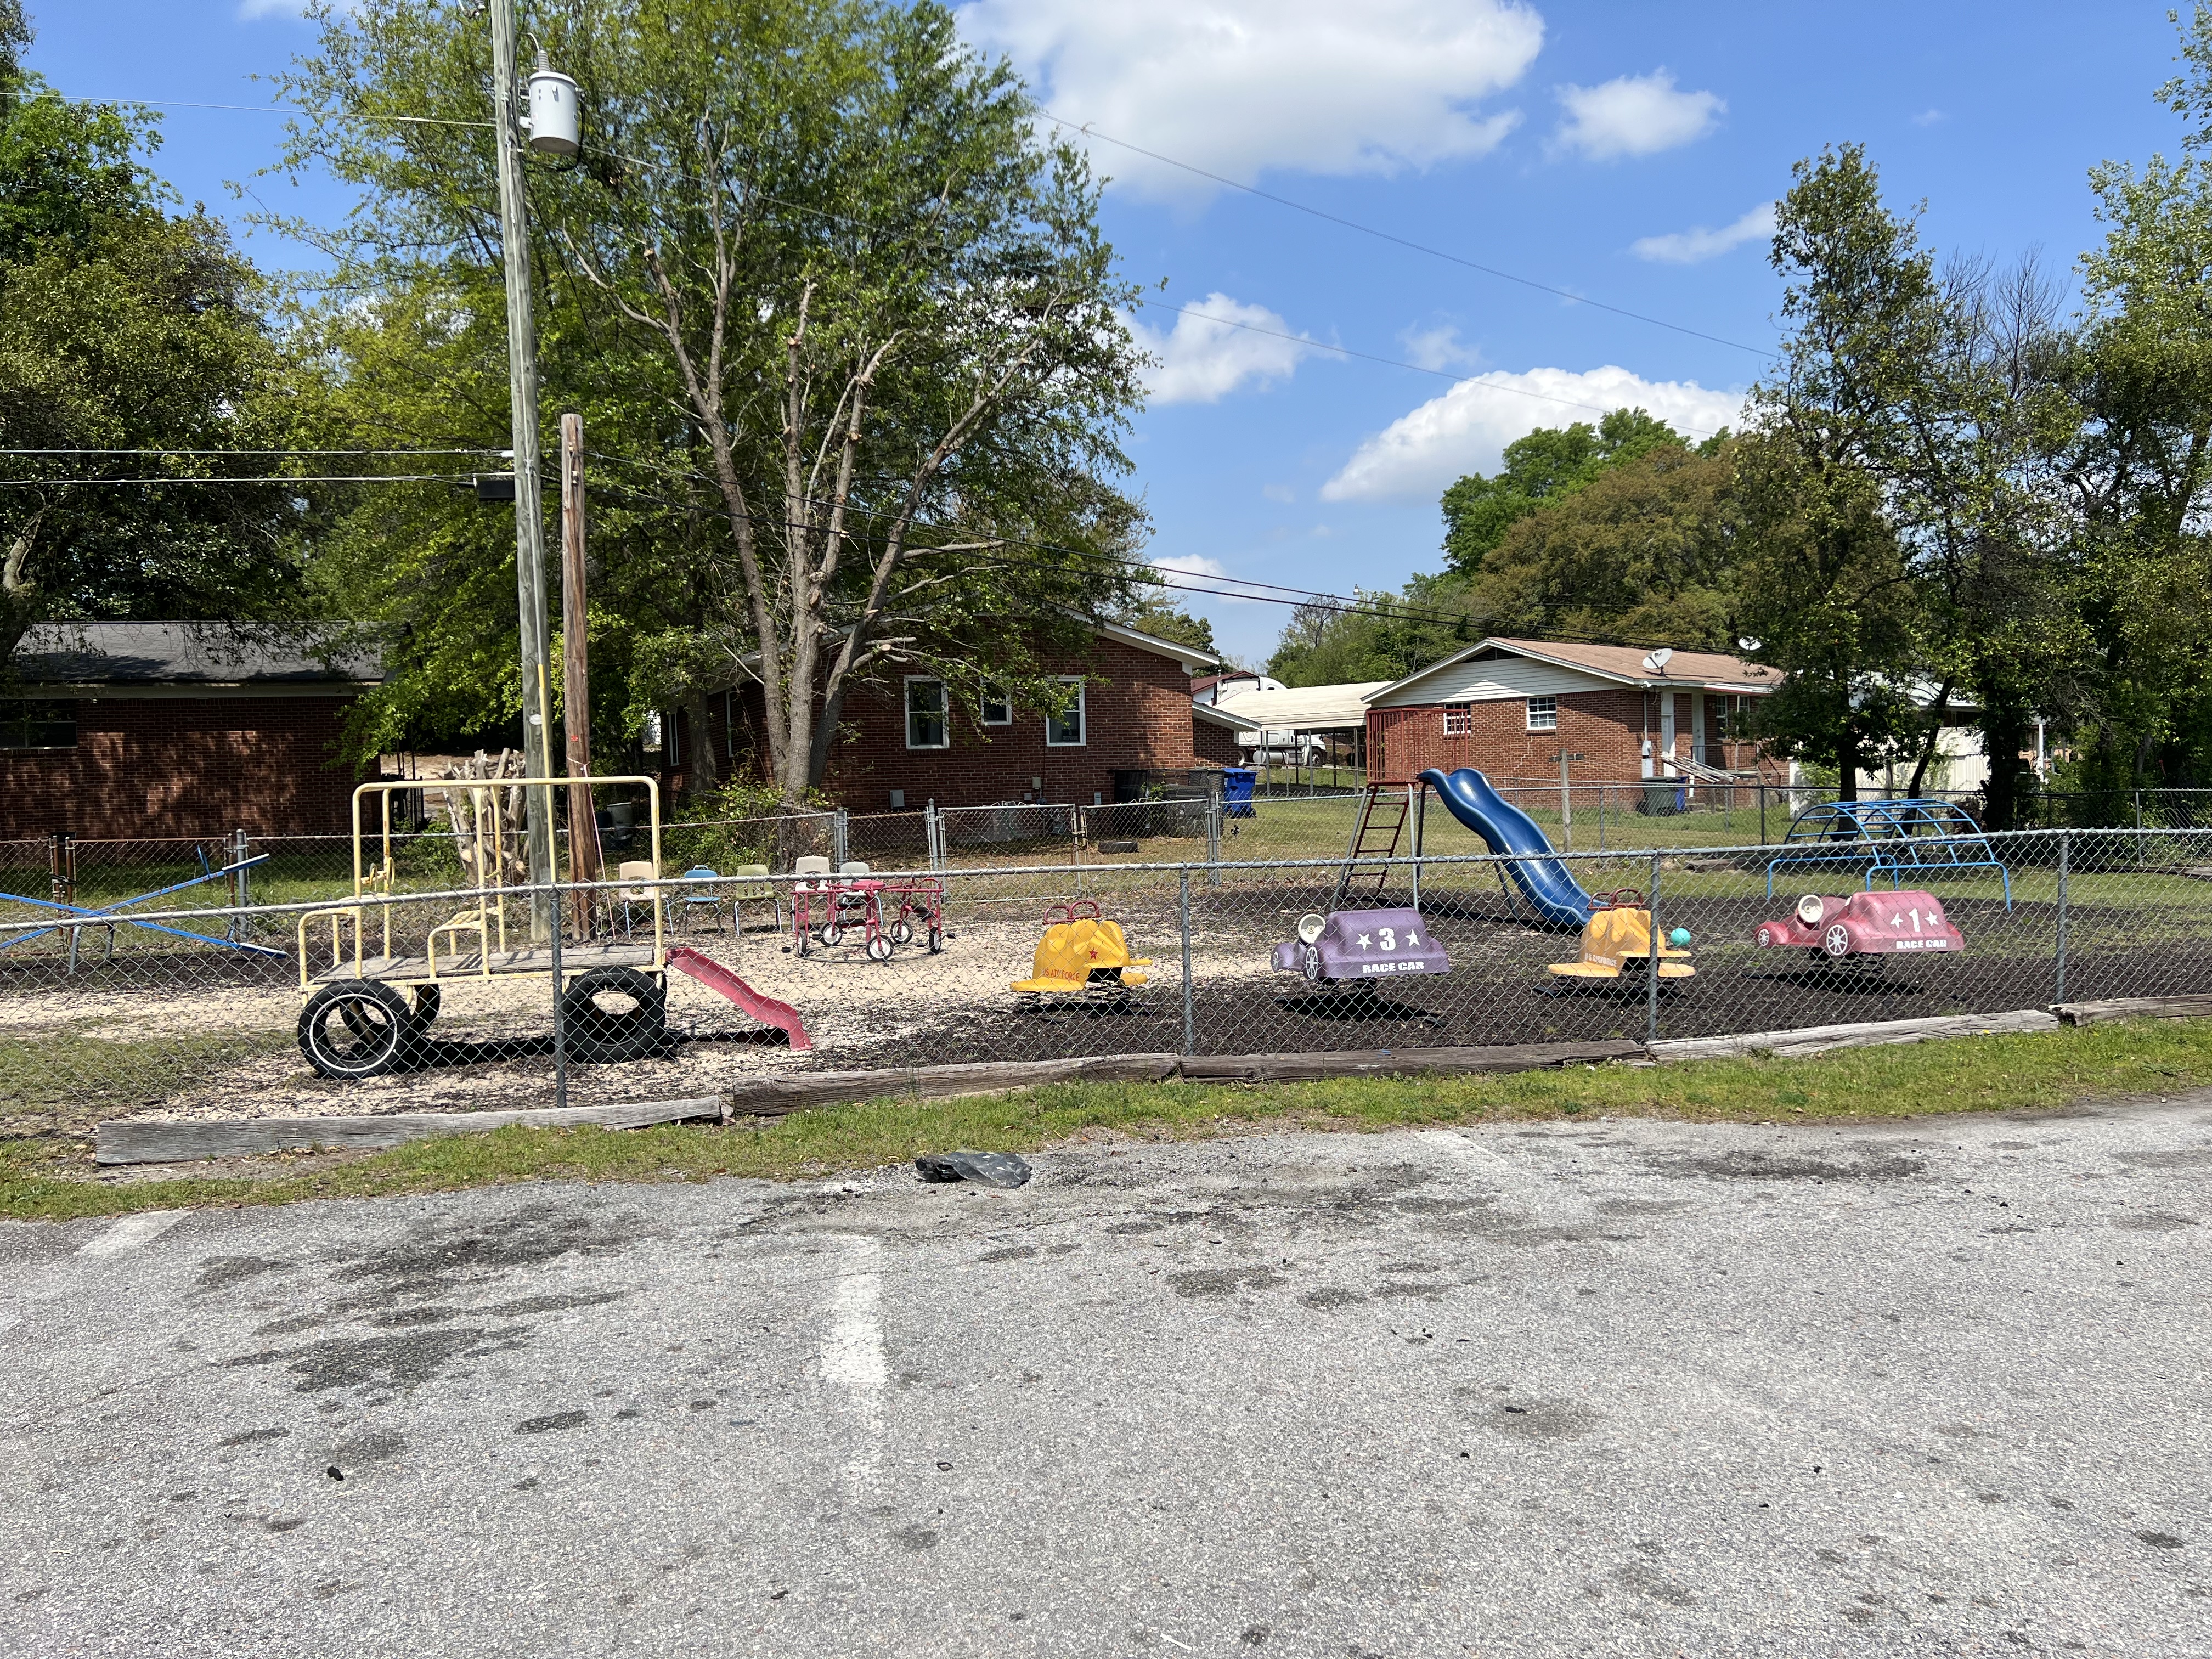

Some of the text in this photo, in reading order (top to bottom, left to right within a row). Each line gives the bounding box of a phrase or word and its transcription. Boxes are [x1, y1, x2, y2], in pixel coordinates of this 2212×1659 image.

[1909, 909, 1920, 932] 1
[1379, 928, 1396, 951] 3
[1896, 939, 1947, 949] RACE CAR
[1362, 961, 1424, 973] RACE CAR
[1051, 969, 1061, 978] AIR
[1062, 970, 1080, 981] FORCE
